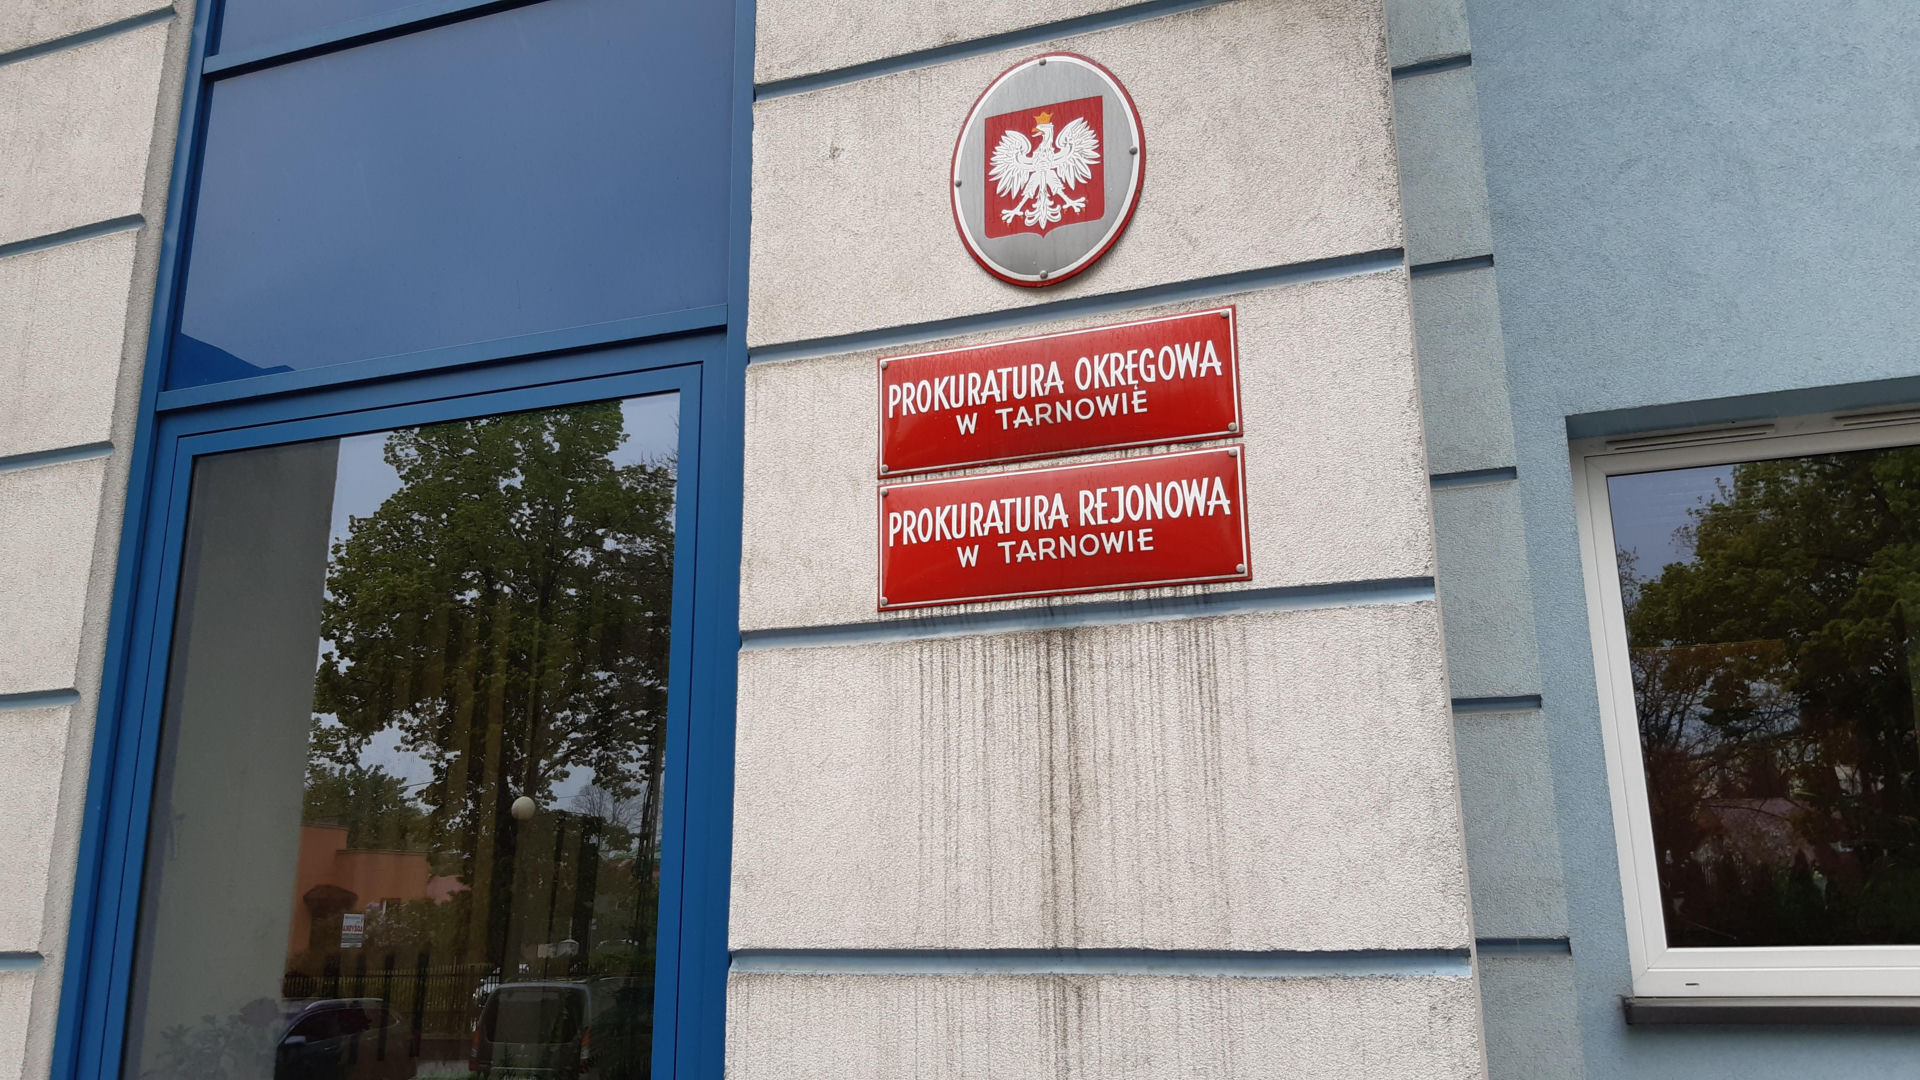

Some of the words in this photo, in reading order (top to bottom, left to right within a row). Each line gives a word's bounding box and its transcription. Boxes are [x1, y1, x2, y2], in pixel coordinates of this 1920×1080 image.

[888, 360, 1065, 419] PROKURATURA
[1074, 339, 1223, 390] OKRĘGOWA
[955, 412, 978, 436] W
[994, 389, 1148, 430] TARNOWIE
[888, 492, 1069, 547] PROKURATURA
[1078, 476, 1231, 527] REJONOWA
[956, 544, 979, 568] W
[997, 528, 1154, 564] TARNOWIE
